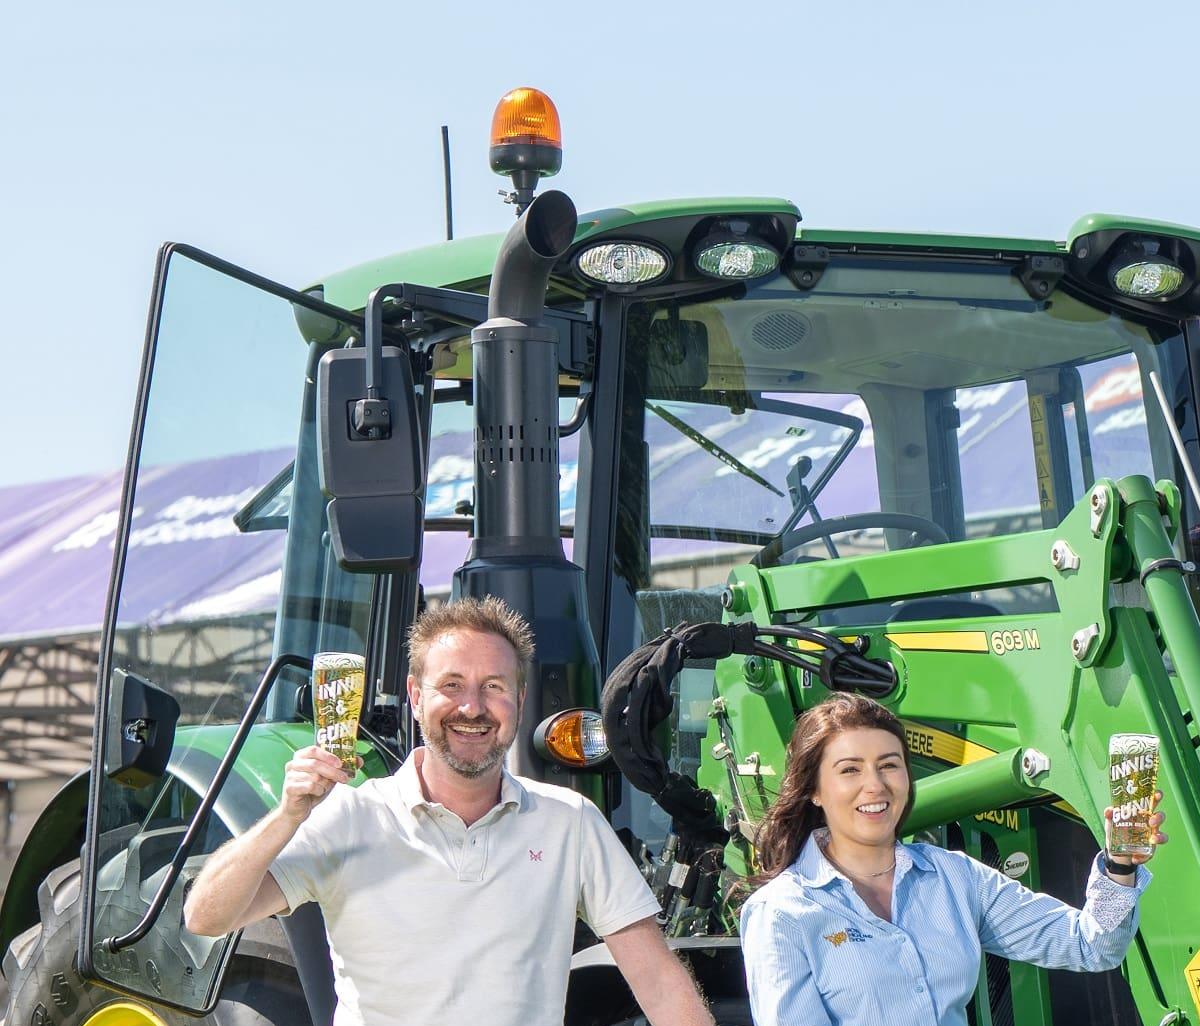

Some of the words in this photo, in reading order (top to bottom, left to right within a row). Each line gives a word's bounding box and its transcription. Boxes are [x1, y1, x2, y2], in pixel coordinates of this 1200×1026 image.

[906, 730, 934, 754] EERE
[1111, 754, 1153, 781] INNIS
[1126, 780, 1138, 794] &
